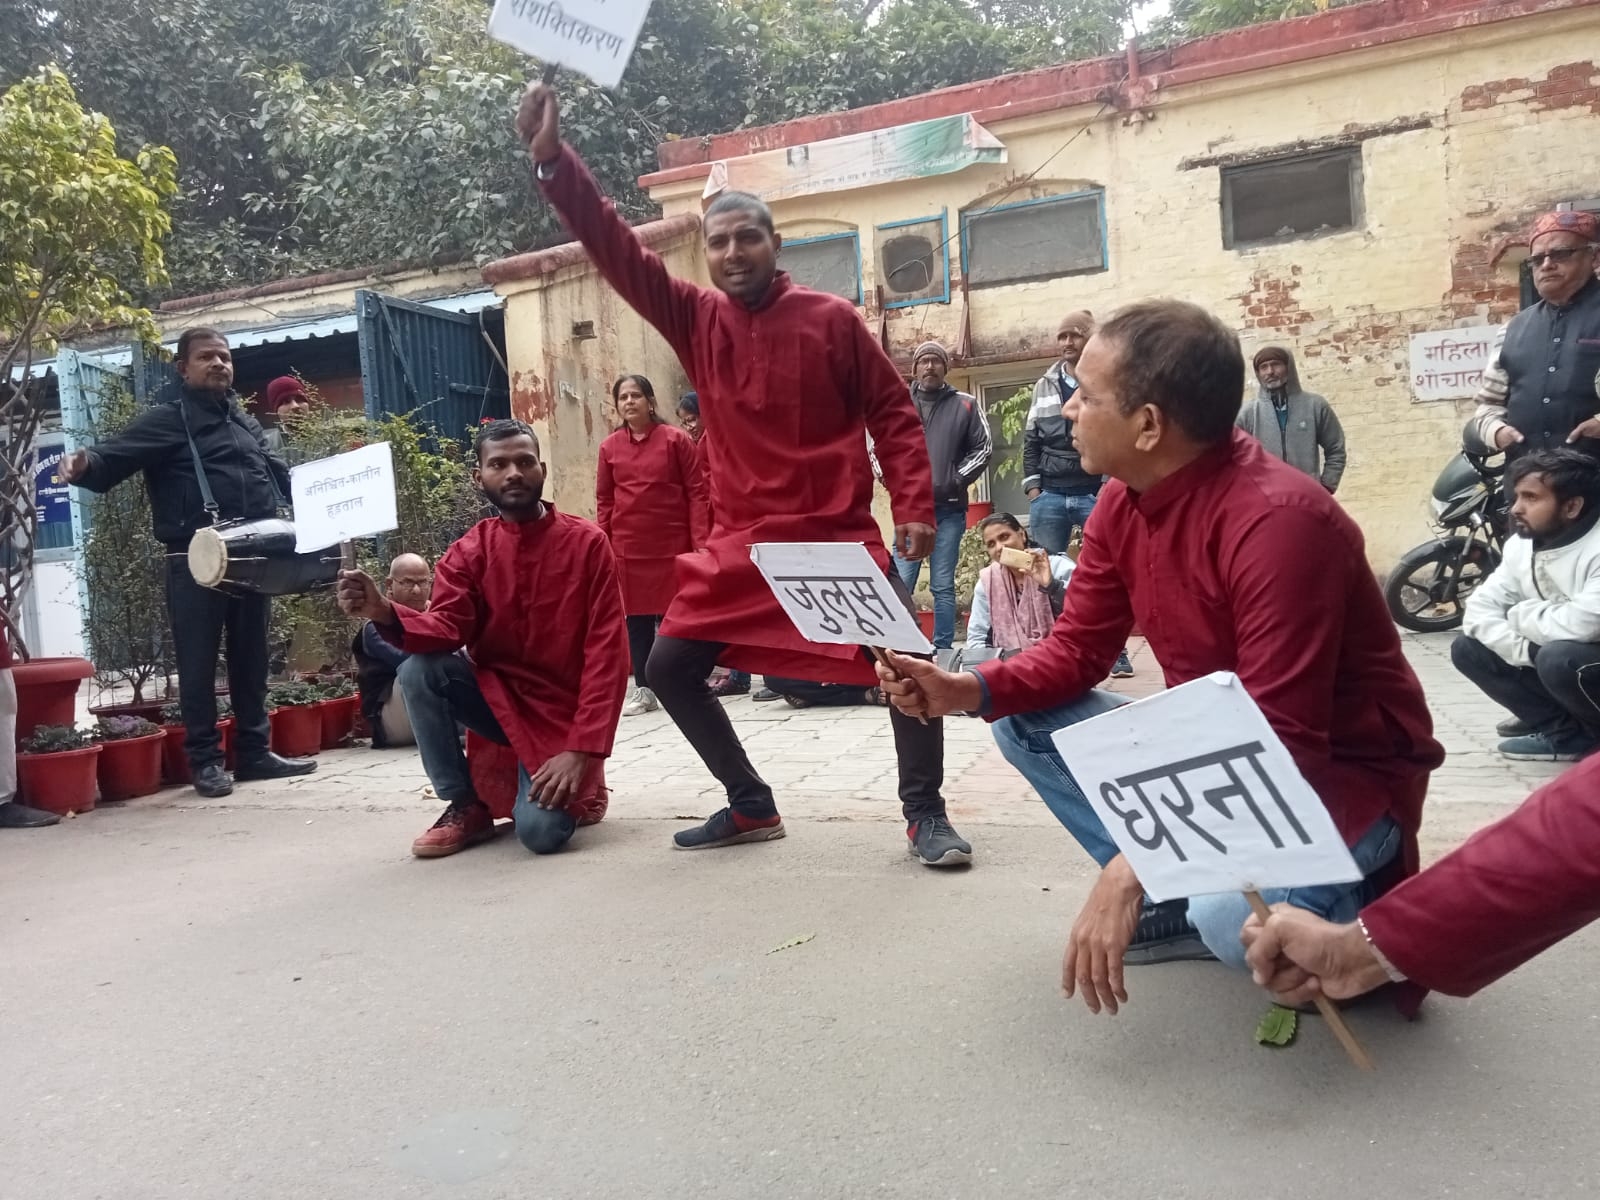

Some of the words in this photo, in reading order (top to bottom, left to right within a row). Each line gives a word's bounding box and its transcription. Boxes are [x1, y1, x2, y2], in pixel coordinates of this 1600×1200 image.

[1424, 338, 1490, 361] महिला
[1415, 368, 1486, 389] शौचाल
[773, 576, 896, 637] जुलूस
[1099, 740, 1314, 862] धरना
